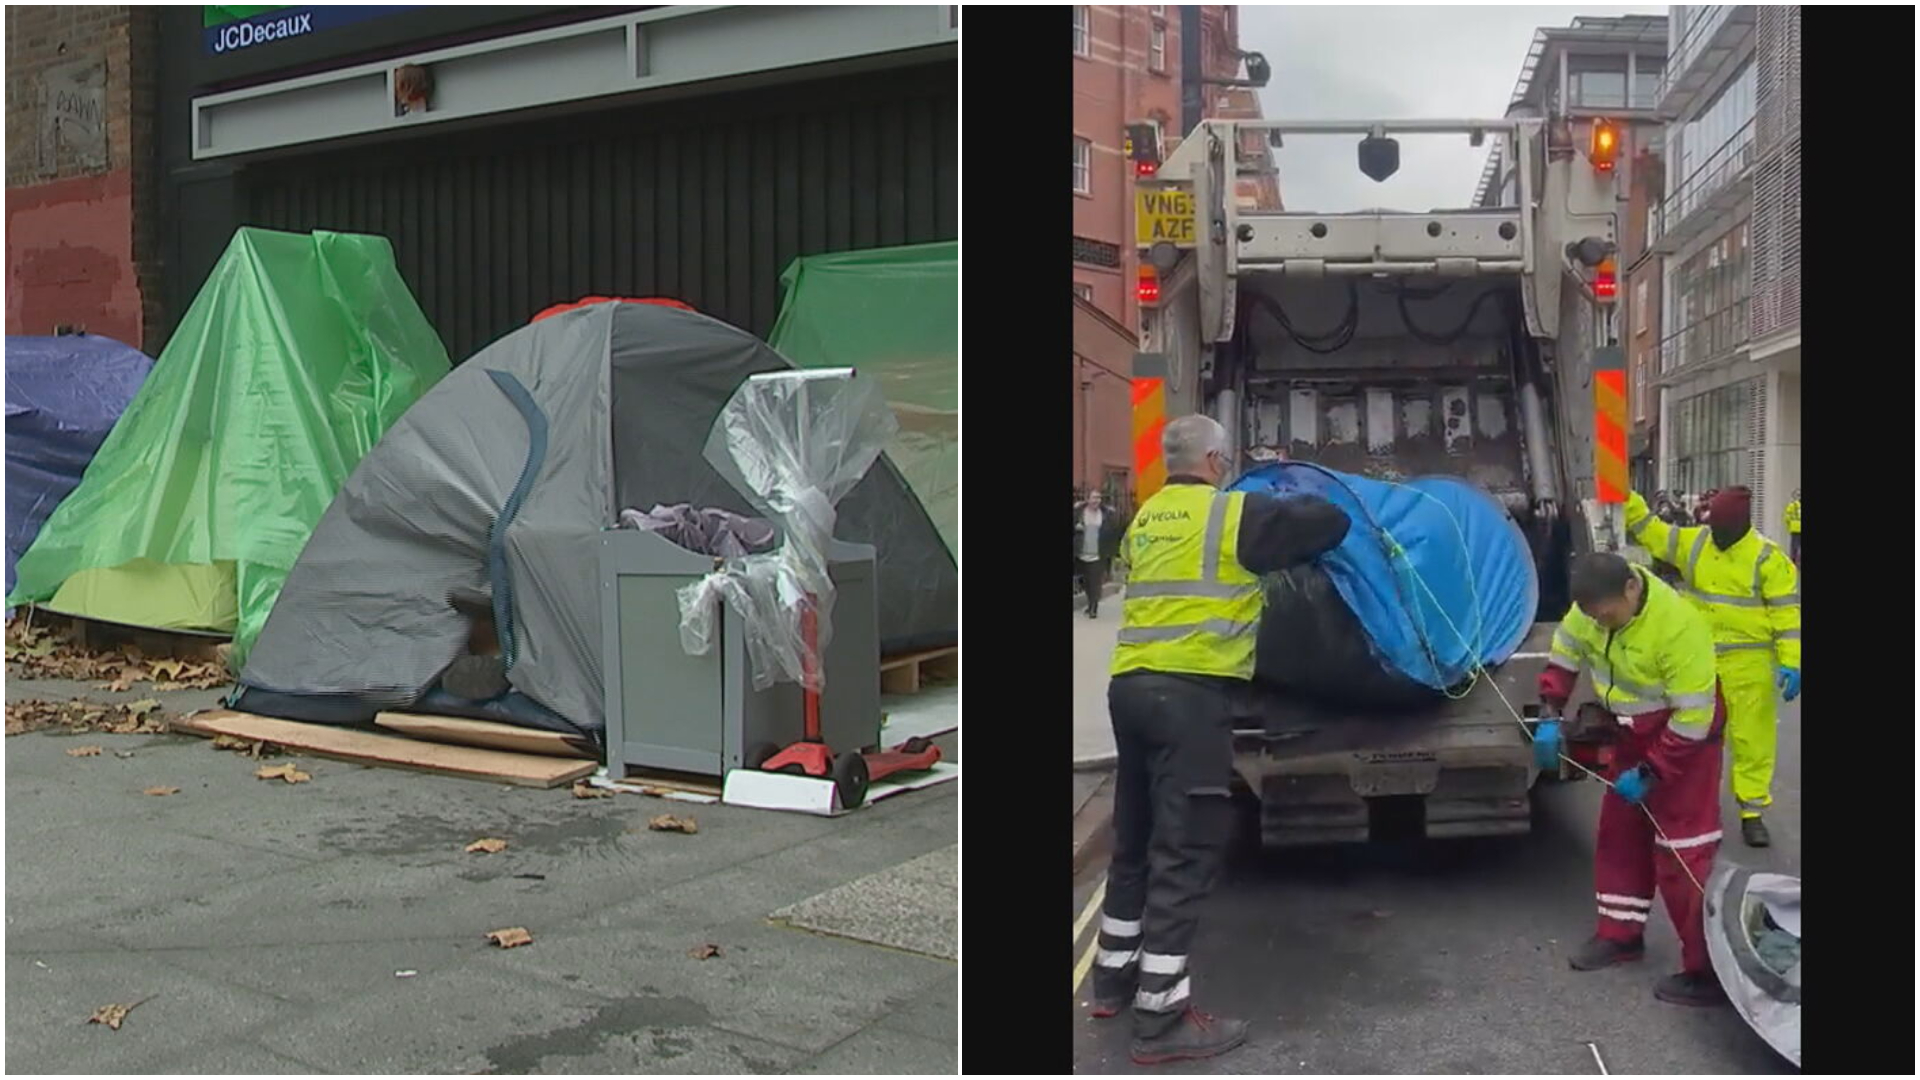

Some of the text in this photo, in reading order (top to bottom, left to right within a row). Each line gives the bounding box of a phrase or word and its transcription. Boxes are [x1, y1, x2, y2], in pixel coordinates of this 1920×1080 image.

[214, 13, 312, 52] JCDecaux
[1153, 218, 1194, 238] AZF
[1151, 510, 1191, 522] VEOLIA
